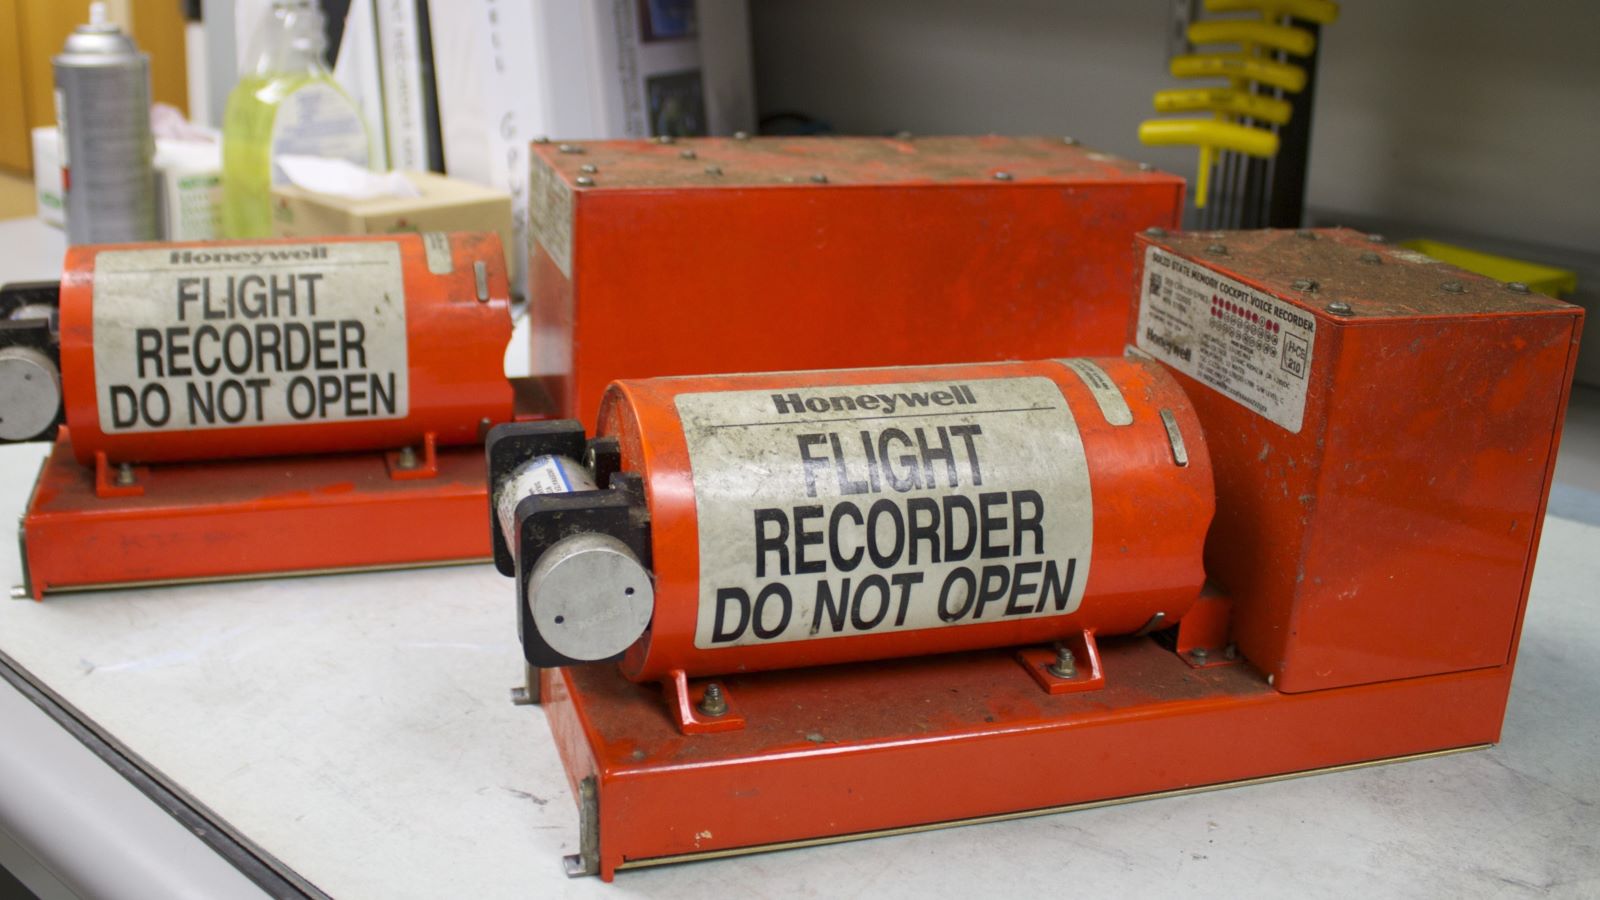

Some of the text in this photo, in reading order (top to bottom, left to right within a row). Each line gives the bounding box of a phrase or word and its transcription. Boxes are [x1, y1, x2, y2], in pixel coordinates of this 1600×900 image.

[170, 247, 328, 265] Honeywell
[177, 273, 323, 321] FLIGHT
[1172, 261, 1190, 277] STATE
[1191, 270, 1219, 288] MEMORY
[1219, 282, 1249, 305] COCKPIT
[1250, 295, 1273, 315] VOICE
[1273, 306, 1314, 333] RECORDER
[136, 320, 367, 378] RECORDER
[1146, 327, 1192, 362] Honeywell
[109, 372, 396, 429] DO NOT OPEN
[771, 385, 977, 414] Honeywell
[797, 424, 982, 498] FLIGHT
[754, 489, 1045, 578] RECORDER
[711, 558, 1077, 644] DO NOT OPEN
